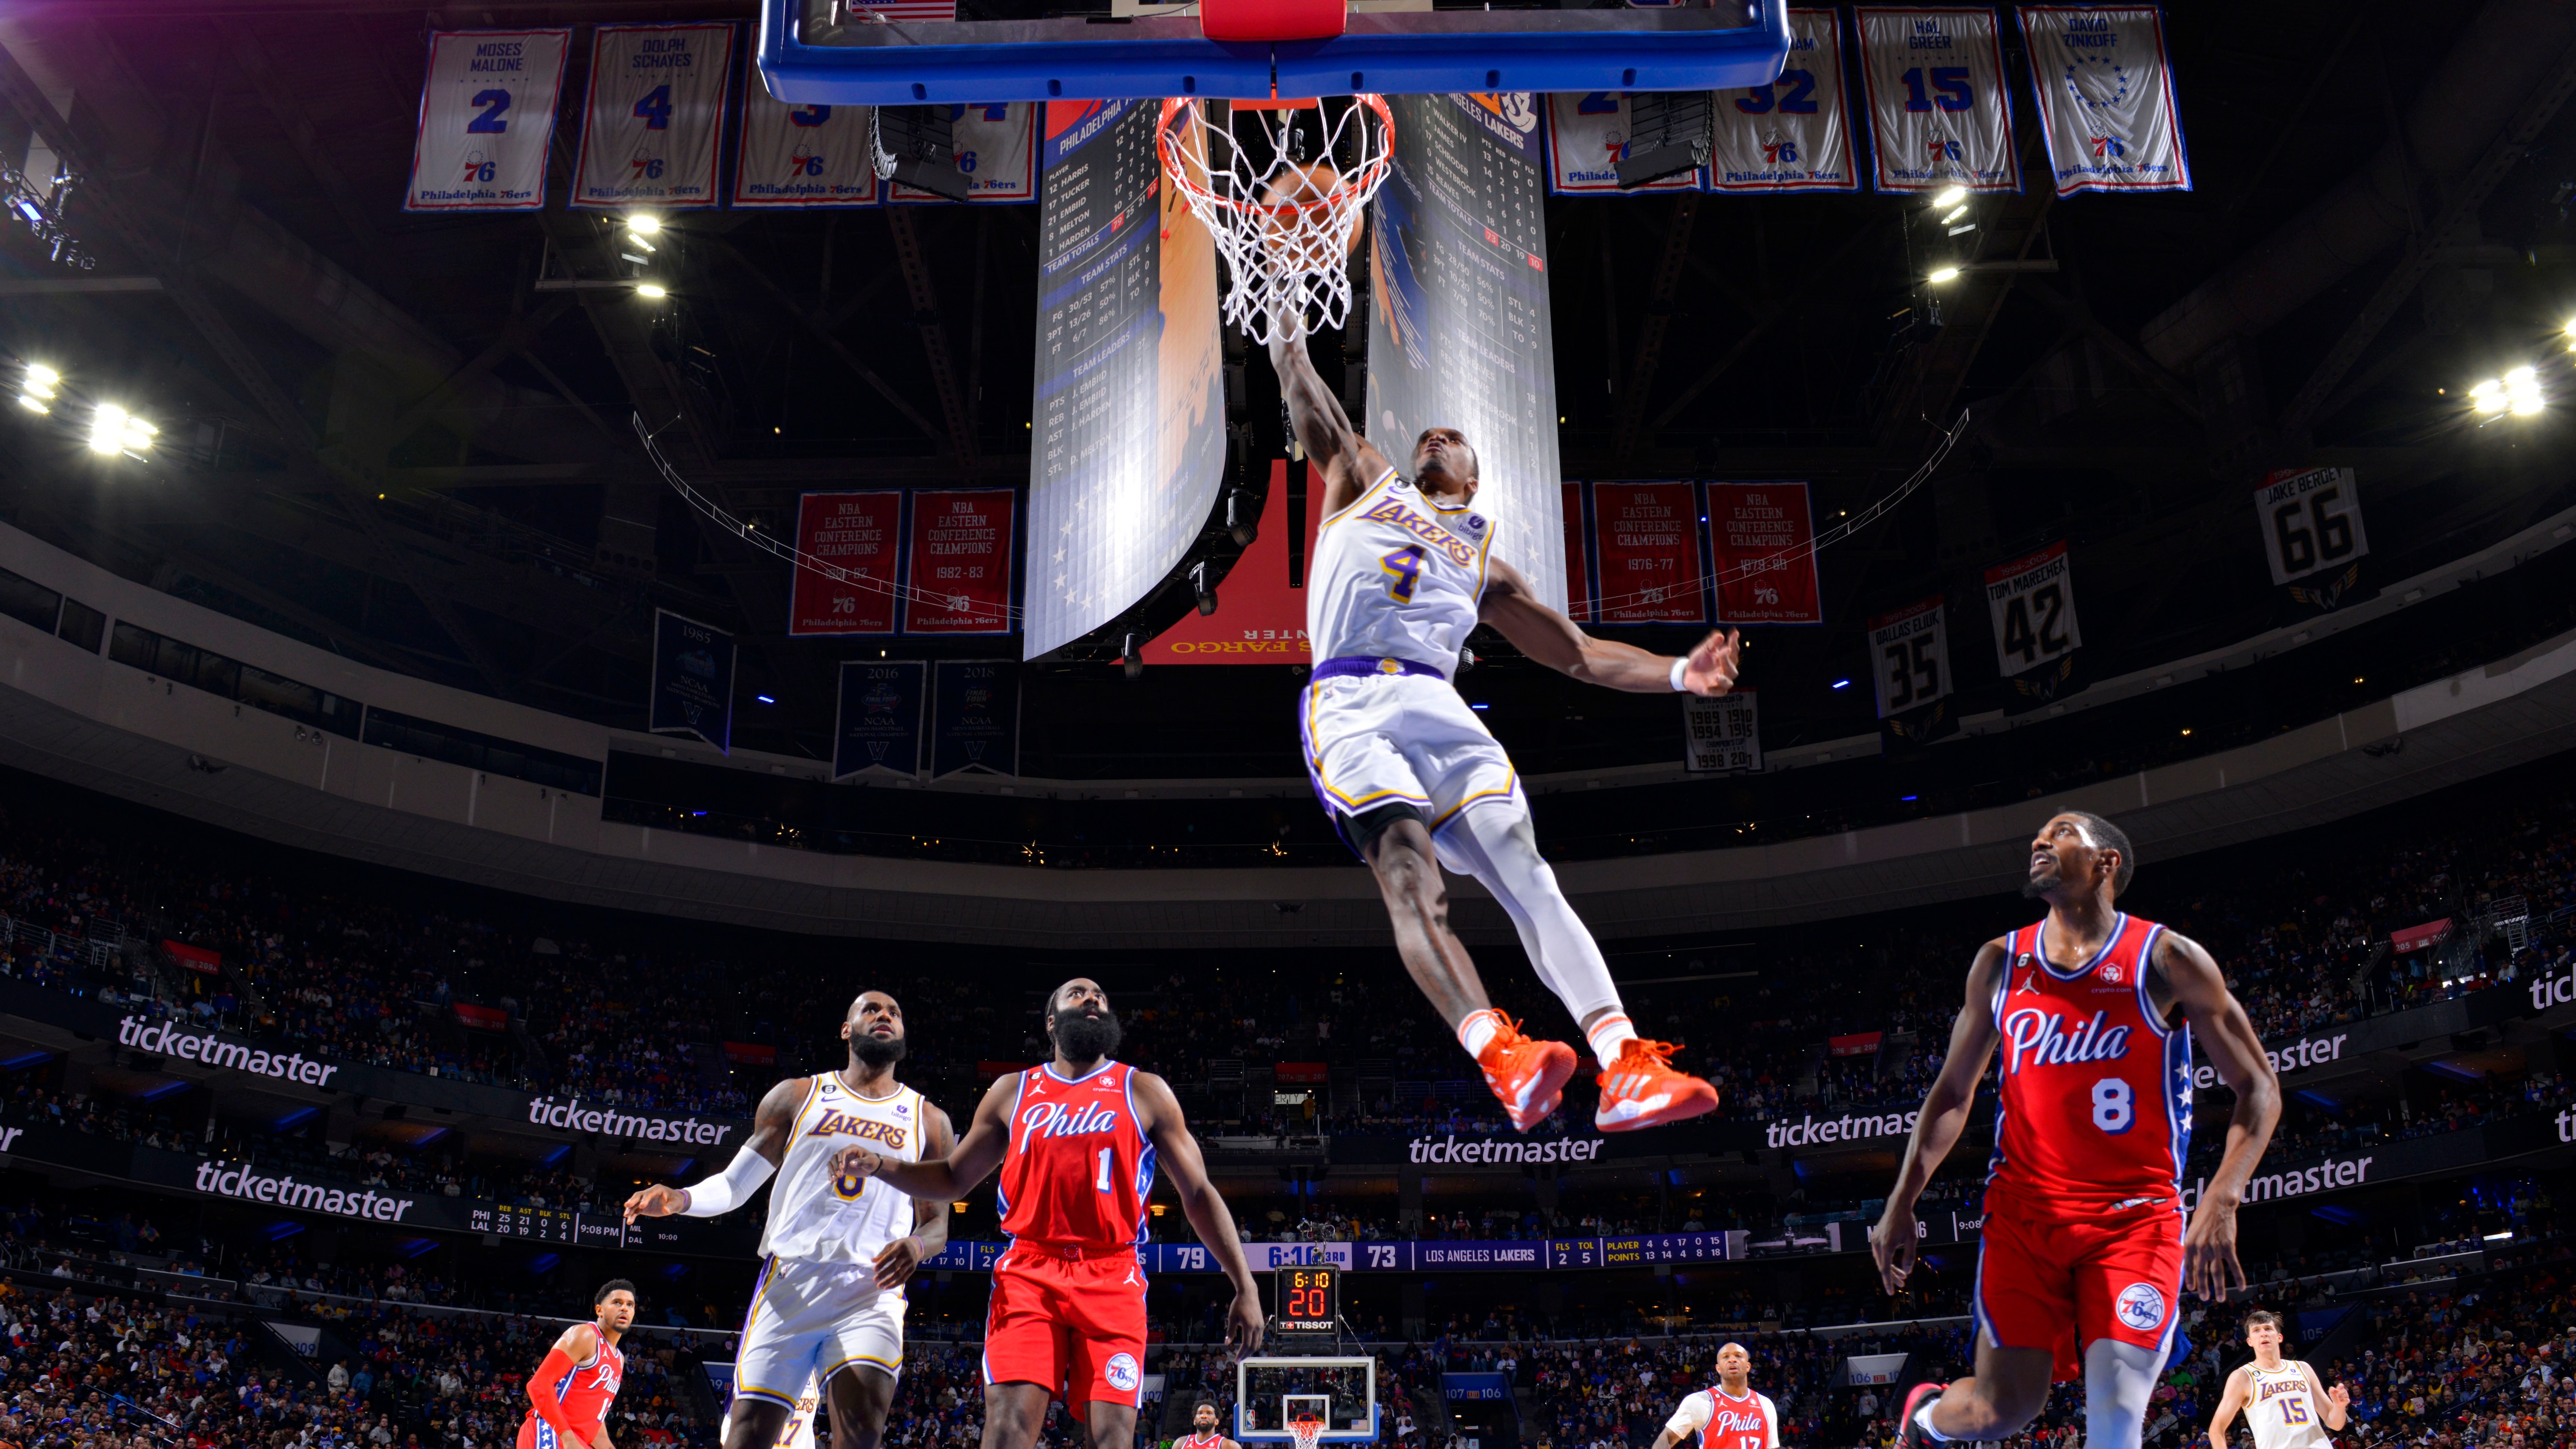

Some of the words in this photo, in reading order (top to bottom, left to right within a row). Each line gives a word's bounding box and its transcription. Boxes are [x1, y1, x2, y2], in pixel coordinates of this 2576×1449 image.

[1916, 21, 1941, 35] HAL
[2069, 19, 2108, 32] DAVID
[643, 38, 685, 53] DOLPH
[1909, 35, 1953, 50] GREER
[2062, 33, 2117, 48] ZINKOFF
[477, 43, 522, 57] MOSES
[471, 58, 523, 72] MALONE
[633, 54, 692, 68] SCHAYES
[1901, 67, 1974, 113] 15
[467, 89, 512, 134] 2
[634, 85, 673, 130] 4
[1060, 99, 1121, 155] PHILADELPHIA
[1433, 107, 1459, 137] WALKER
[1459, 132, 1467, 144] IV
[1485, 113, 1524, 150] LAKERS
[1434, 124, 1454, 148] JAMES
[1763, 142, 1798, 163] 76
[1927, 140, 1962, 162] 76
[2091, 136, 2125, 157] 76
[1435, 140, 1469, 177] SCHRODER
[464, 161, 496, 182] 76
[633, 159, 664, 180] 76
[791, 156, 824, 177] 76
[1049, 165, 1069, 181] PLAYER
[1893, 169, 1969, 180] Philadelphia
[1972, 168, 2005, 179] 76ers
[2059, 165, 2134, 180] Philadelphia
[2136, 162, 2168, 173] 76ers
[1061, 163, 1089, 188] HARRIS
[1435, 156, 1476, 197] WESTBROOK
[1726, 171, 1804, 181] Philadelphia
[1808, 170, 1841, 180] 76ers
[589, 185, 665, 198] Philadelphia
[669, 185, 701, 195] 76ers
[749, 183, 825, 196] Philadelphia
[829, 184, 862, 194] 76ers
[984, 179, 1016, 190] 76ers
[1061, 178, 1090, 203] TUCKER
[1436, 173, 1460, 200] REAVES
[421, 189, 496, 201] Philadelphia
[500, 190, 531, 200] 76ers
[1060, 196, 1087, 219] EMBIID
[1429, 180, 1446, 205] TEAM
[1447, 200, 1472, 226] TOTALS
[1059, 209, 1090, 235] MELTON
[1059, 225, 1090, 251] HARDEN
[1048, 254, 1070, 274] TEAM
[1072, 234, 1099, 260] TOTALS
[1458, 240, 1479, 265] TEAM
[1481, 258, 1505, 281] STATS
[1081, 263, 1104, 284] TEAM
[1105, 244, 1127, 268] STATS
[1073, 356, 1096, 378] TEAM
[1097, 331, 1130, 362] LEADERS
[1634, 493, 1656, 506] NBA
[1747, 494, 1769, 506] NBA
[2267, 481, 2296, 504] JAKE
[838, 503, 861, 516] NBA
[952, 502, 974, 514] NBA
[1622, 506, 1672, 518] EASTERN
[1734, 507, 1783, 519] EASTERN
[825, 515, 874, 529] EASTERN
[938, 514, 987, 528] EASTERN
[1614, 520, 1682, 533] CONFERENCE
[1726, 520, 1794, 533] CONFERENCE
[814, 529, 882, 542] CONFERENCE
[927, 527, 996, 541] CONFERENCE
[1353, 495, 1478, 568] LAKERS
[1458, 523, 1484, 541] bibigo
[2273, 485, 2354, 575] 66
[1617, 533, 1680, 546] CHAMPIONS
[1731, 533, 1793, 546] CHAMPIONS
[816, 542, 878, 555] CHAMPIONS
[930, 542, 992, 555] CHAMPIONS
[1628, 558, 1674, 570] 1976-77
[2001, 552, 2048, 577] 1994-2005
[936, 566, 984, 579] 1982-83
[1379, 544, 1427, 604] 4
[1989, 581, 2011, 601] TOM
[2013, 557, 2066, 593] MARECHEK
[1613, 609, 1668, 618] Philadelphia
[1671, 608, 1695, 616] 76ers
[916, 617, 972, 626] Philadelphia
[975, 616, 998, 625] 76ers
[1876, 621, 1910, 645] DALLAS
[1912, 609, 1939, 633] ELIUK
[2004, 583, 2071, 665] 42
[682, 625, 711, 644] 1985
[867, 667, 899, 679] 2016
[964, 667, 995, 679] 2018
[1885, 631, 1939, 710] 35
[680, 674, 708, 694] NCAA
[864, 716, 895, 727] NCAA
[961, 716, 992, 726] NCAA
[1690, 711, 1720, 724] 1989
[1691, 725, 1721, 738] 1994
[1696, 754, 1724, 768] 1998
[2005, 1008, 2133, 1075] Phila
[118, 1014, 337, 1086] ticketmaster
[2091, 1077, 2136, 1135] 8
[529, 1096, 732, 1145] ticketmaster
[891, 1110, 911, 1121] bibigo
[807, 1108, 908, 1150] LAKERS
[1019, 1101, 1118, 1155] Phila
[1409, 1135, 1604, 1164] ticketmaster
[1096, 1147, 1113, 1194] 1
[195, 1160, 413, 1222] ticketmaster
[472, 1209, 490, 1221] PHI
[498, 1214, 511, 1223] 25
[519, 1216, 530, 1225] 21
[471, 1220, 489, 1232] LAL
[497, 1224, 510, 1234] 20
[518, 1226, 529, 1236] 19
[580, 1224, 602, 1235] 9:08
[603, 1226, 619, 1236] PM
[630, 1224, 642, 1233] MIL
[628, 1236, 643, 1244] DAL
[658, 1233, 678, 1241] 10:00
[1555, 1243, 1570, 1251] FLS
[1578, 1241, 1594, 1250] TOL
[1607, 1241, 1639, 1250] PLAYER
[1177, 1247, 1205, 1269] 79
[1326, 1252, 1345, 1262] 3RD
[1368, 1245, 1396, 1267] 73
[1426, 1250, 1445, 1262] LOS
[1447, 1249, 1489, 1262] ANGELES
[1494, 1249, 1535, 1262] LAKERS
[1608, 1253, 1639, 1262] POINTS
[1295, 1272, 1329, 1288] 6:10
[1289, 1288, 1325, 1316] 20
[2122, 1299, 2158, 1322] 76ers
[1295, 1321, 1334, 1329] TISSOT
[2302, 1327, 2323, 1341] 105
[1851, 1373, 1871, 1384] 106
[1481, 1388, 1502, 1399] 106
[2260, 1380, 2308, 1402] LAKERS
[2278, 1397, 2310, 1426] 15
[1717, 1411, 1761, 1437] Phila
